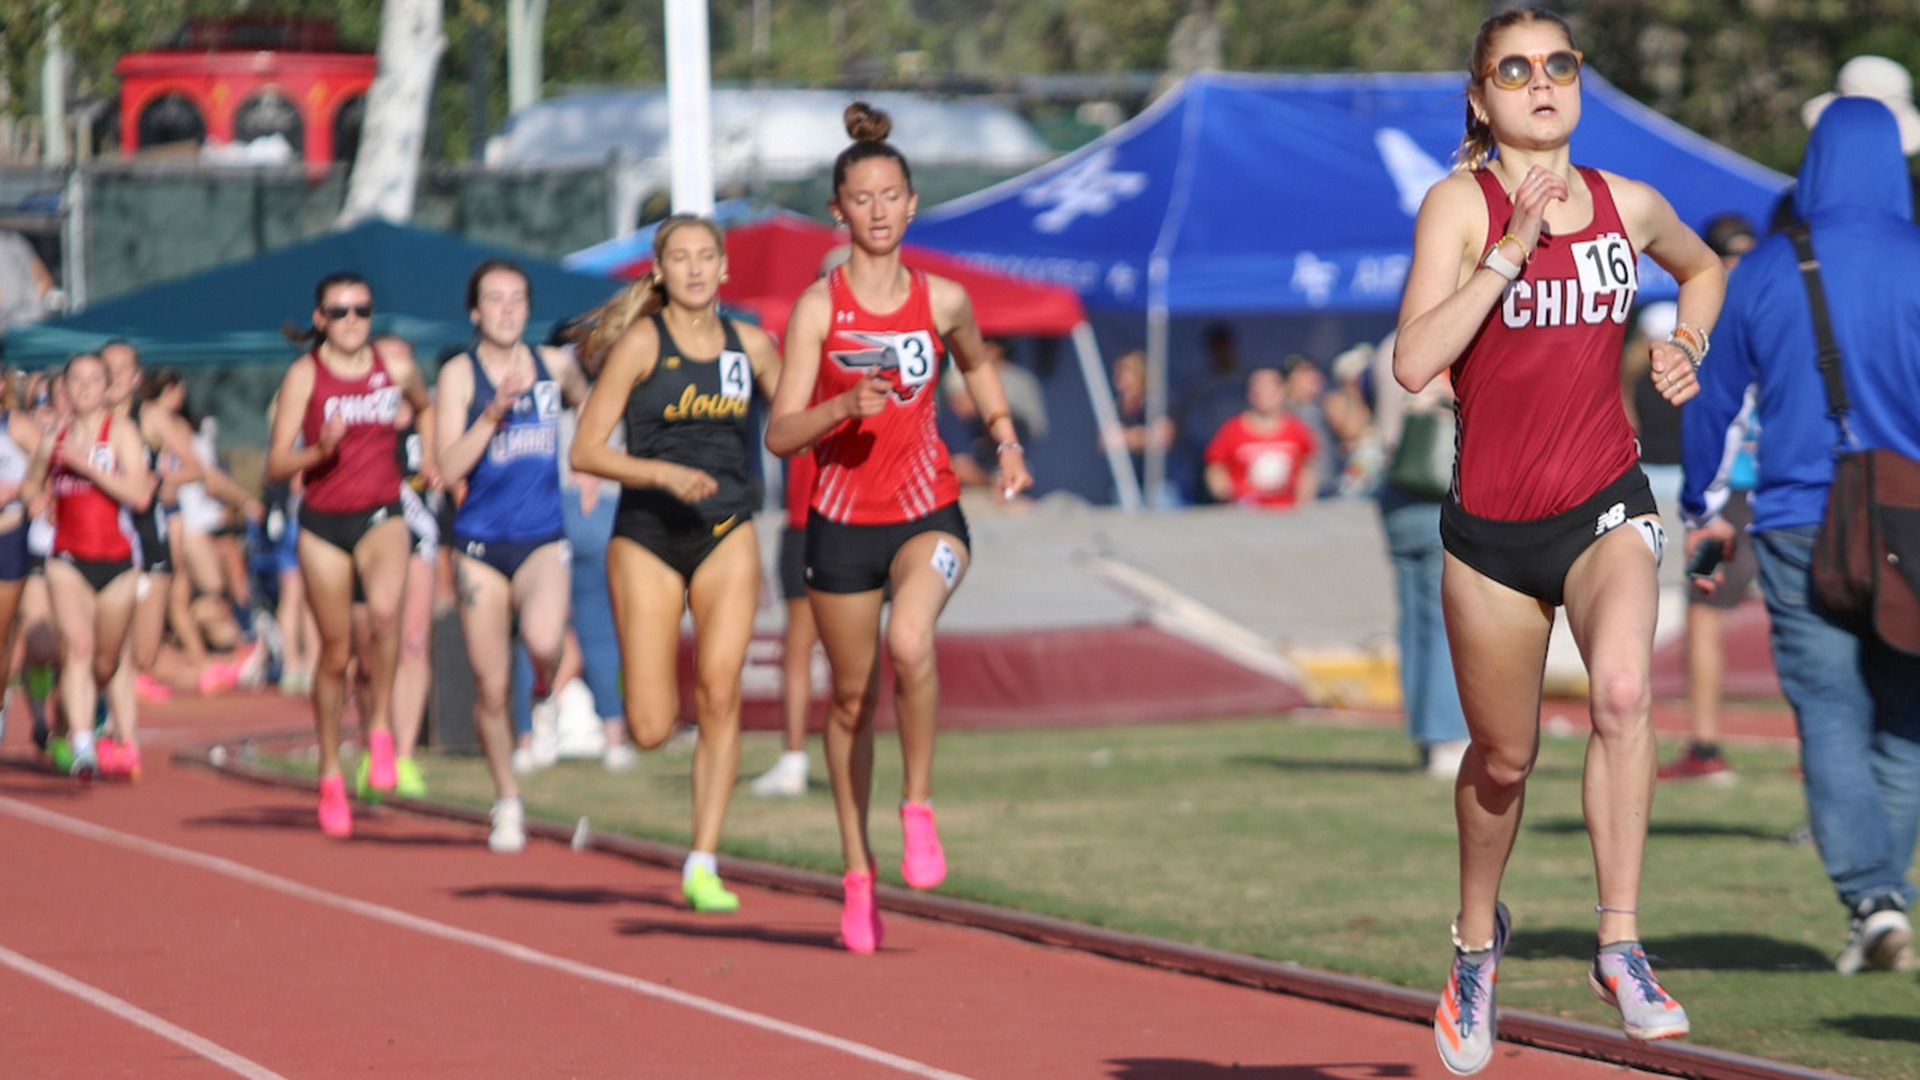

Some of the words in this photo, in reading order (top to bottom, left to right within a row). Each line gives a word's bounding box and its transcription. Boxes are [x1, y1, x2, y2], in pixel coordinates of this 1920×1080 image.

[1585, 242, 1629, 288] 16
[1502, 278, 1635, 330] CHICO
[726, 357, 744, 392] 4
[903, 336, 928, 378] 3
[663, 383, 750, 422] Iowa
